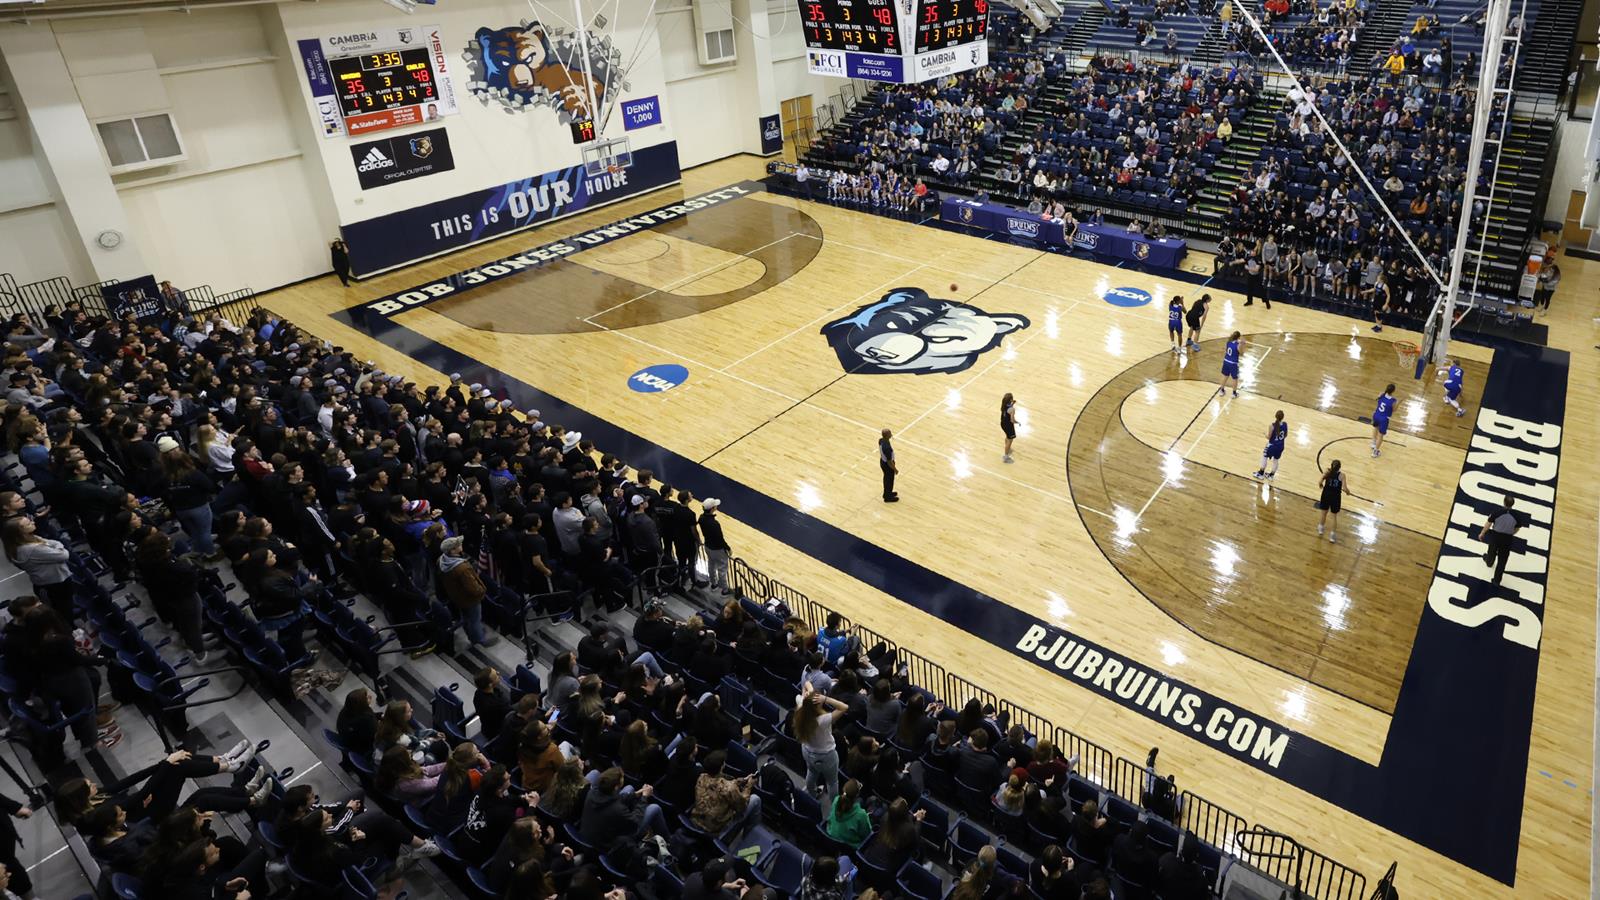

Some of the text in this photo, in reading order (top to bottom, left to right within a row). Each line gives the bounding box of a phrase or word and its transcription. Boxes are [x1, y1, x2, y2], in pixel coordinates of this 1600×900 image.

[808, 4, 824, 20] 35
[842, 8, 850, 20] 3
[873, 8, 891, 24] 48
[925, 6, 938, 23] 35
[952, 4, 958, 16] 3
[947, 27, 955, 38] 14
[957, 25, 962, 37] 3
[967, 24, 972, 34] 4
[979, 21, 984, 32] 2
[815, 29, 819, 39] 1
[825, 29, 832, 41] 3
[842, 31, 852, 41] 14
[855, 31, 862, 44] 3
[869, 33, 876, 44] 4
[887, 34, 894, 46] 2
[925, 32, 928, 43] 1
[934, 29, 940, 42] 3
[431, 31, 447, 73] VISION
[372, 51, 400, 68] 3:35
[820, 54, 842, 68] FCI
[383, 77, 391, 87] 3
[412, 70, 430, 82] 48
[347, 80, 365, 94] 35
[426, 87, 432, 97] 2
[383, 94, 393, 103] 14
[396, 92, 403, 101] 3
[409, 90, 417, 98] 4
[353, 100, 358, 108] 1
[365, 96, 373, 106] 3
[319, 101, 334, 122] FCI
[626, 102, 654, 114] DENNY
[633, 113, 652, 123] 1,000
[582, 128, 592, 140] 17
[358, 160, 394, 172] adidas
[384, 165, 433, 180] OFFICIAL OUTFITTER
[431, 170, 628, 240] THIS IS OUR HOUSE
[1010, 220, 1036, 232] BRUINS
[366, 186, 749, 316] BOB JONES UNIVERSITY
[1106, 288, 1150, 301] NCAA
[1227, 347, 1232, 356] 0
[632, 372, 675, 391] NCAA
[1378, 402, 1386, 412] 5
[1428, 407, 1561, 650] BRUINS
[1015, 624, 1290, 769] BJUBRUINS.COM
